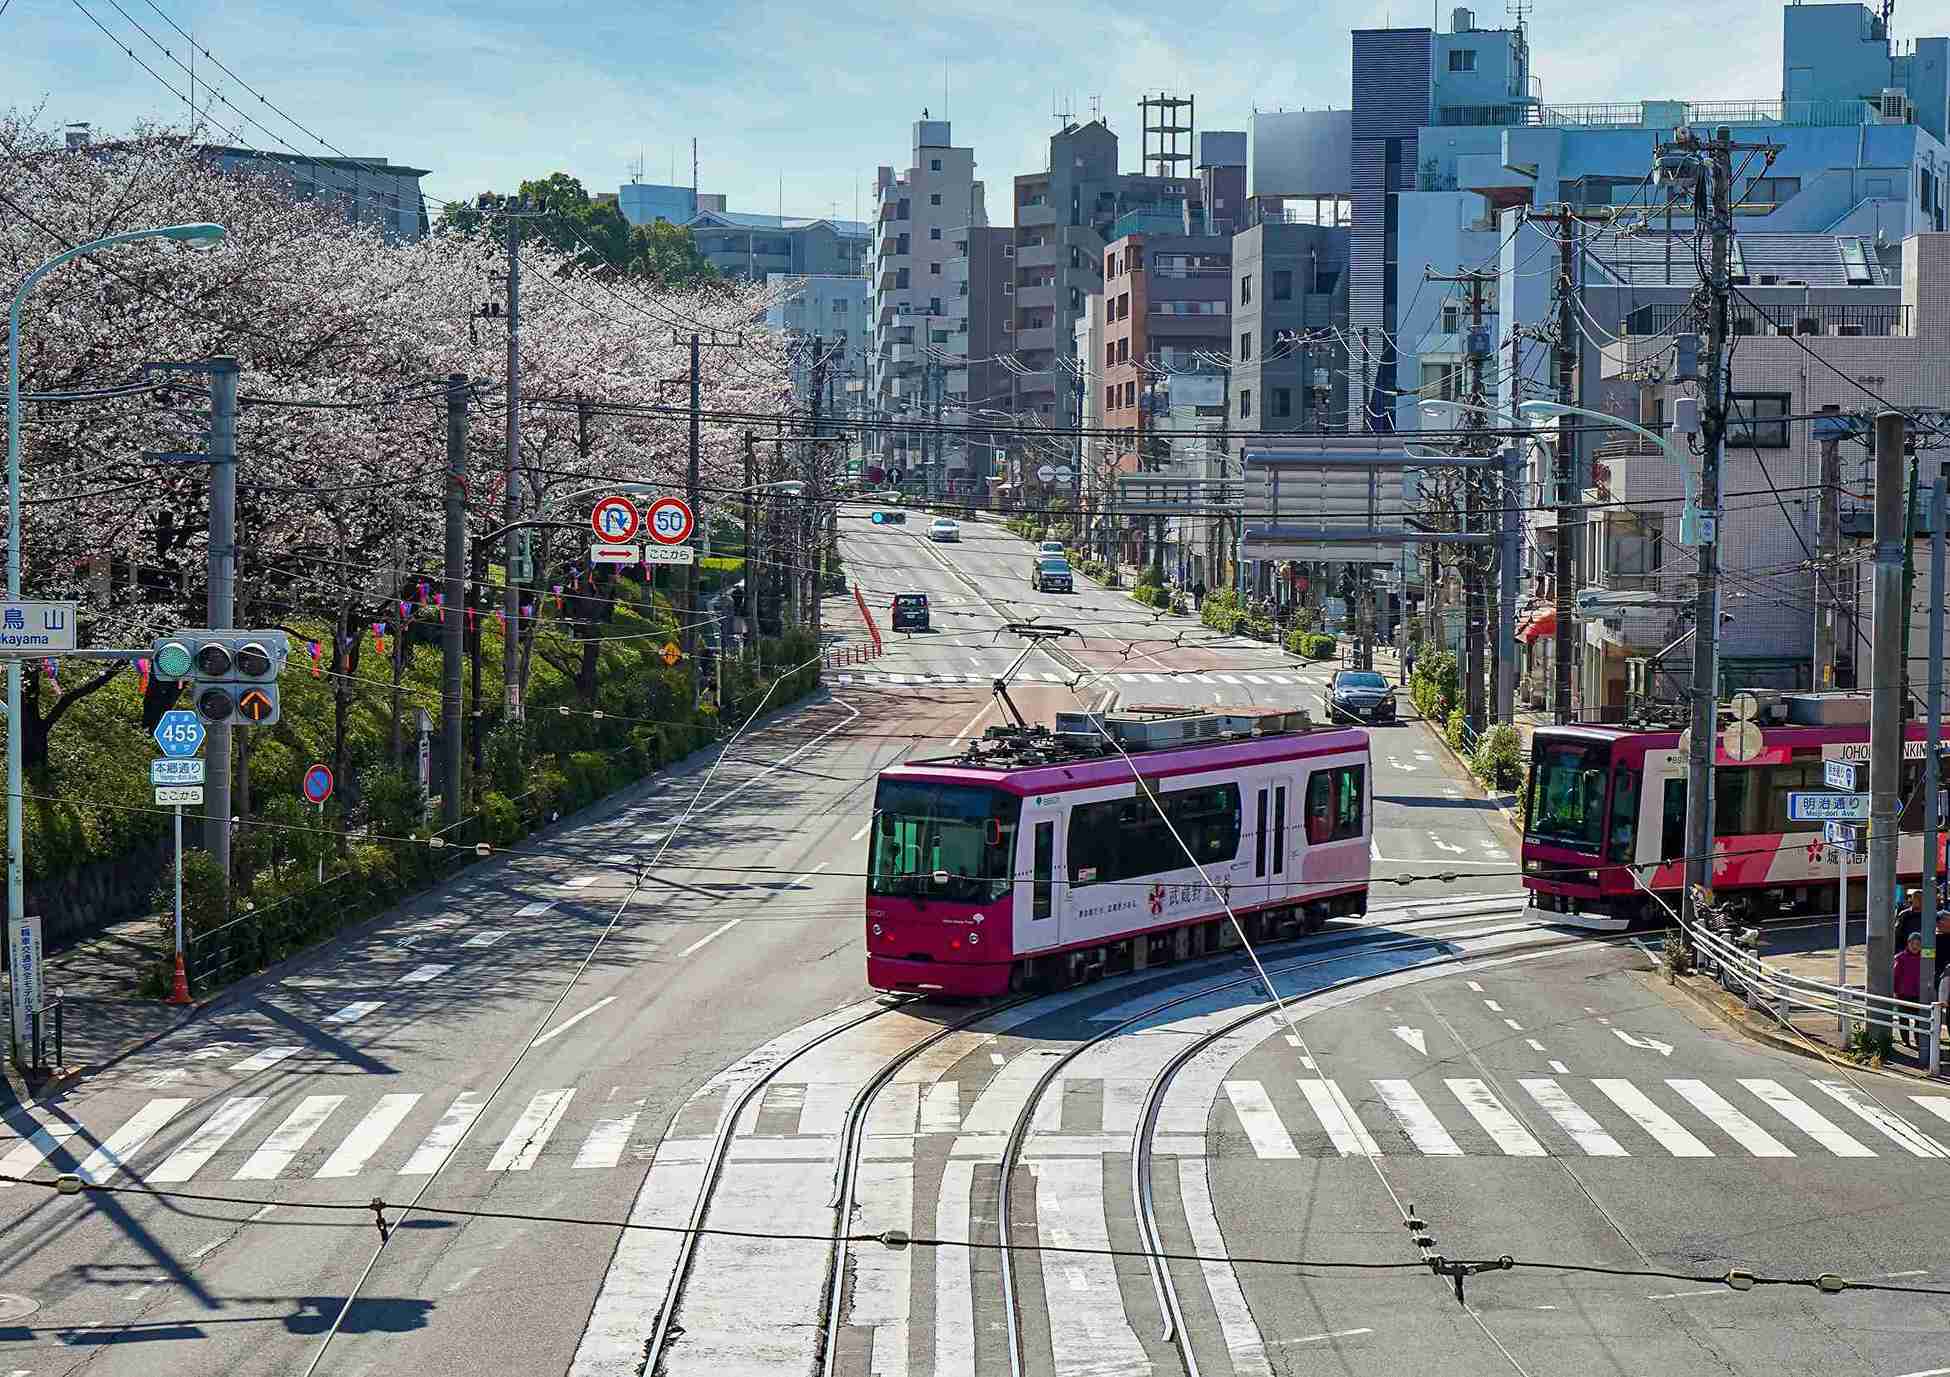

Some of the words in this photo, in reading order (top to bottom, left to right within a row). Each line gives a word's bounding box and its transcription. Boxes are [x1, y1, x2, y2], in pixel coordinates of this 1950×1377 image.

[656, 511, 682, 531] 50
[650, 549, 689, 560] ここから
[2, 608, 65, 630] 鳥山
[1, 633, 49, 647] kayama
[163, 724, 197, 742] 455
[1840, 744, 1870, 760] JOHO
[159, 790, 201, 801] ここから
[1803, 797, 1860, 810] 明治通り
